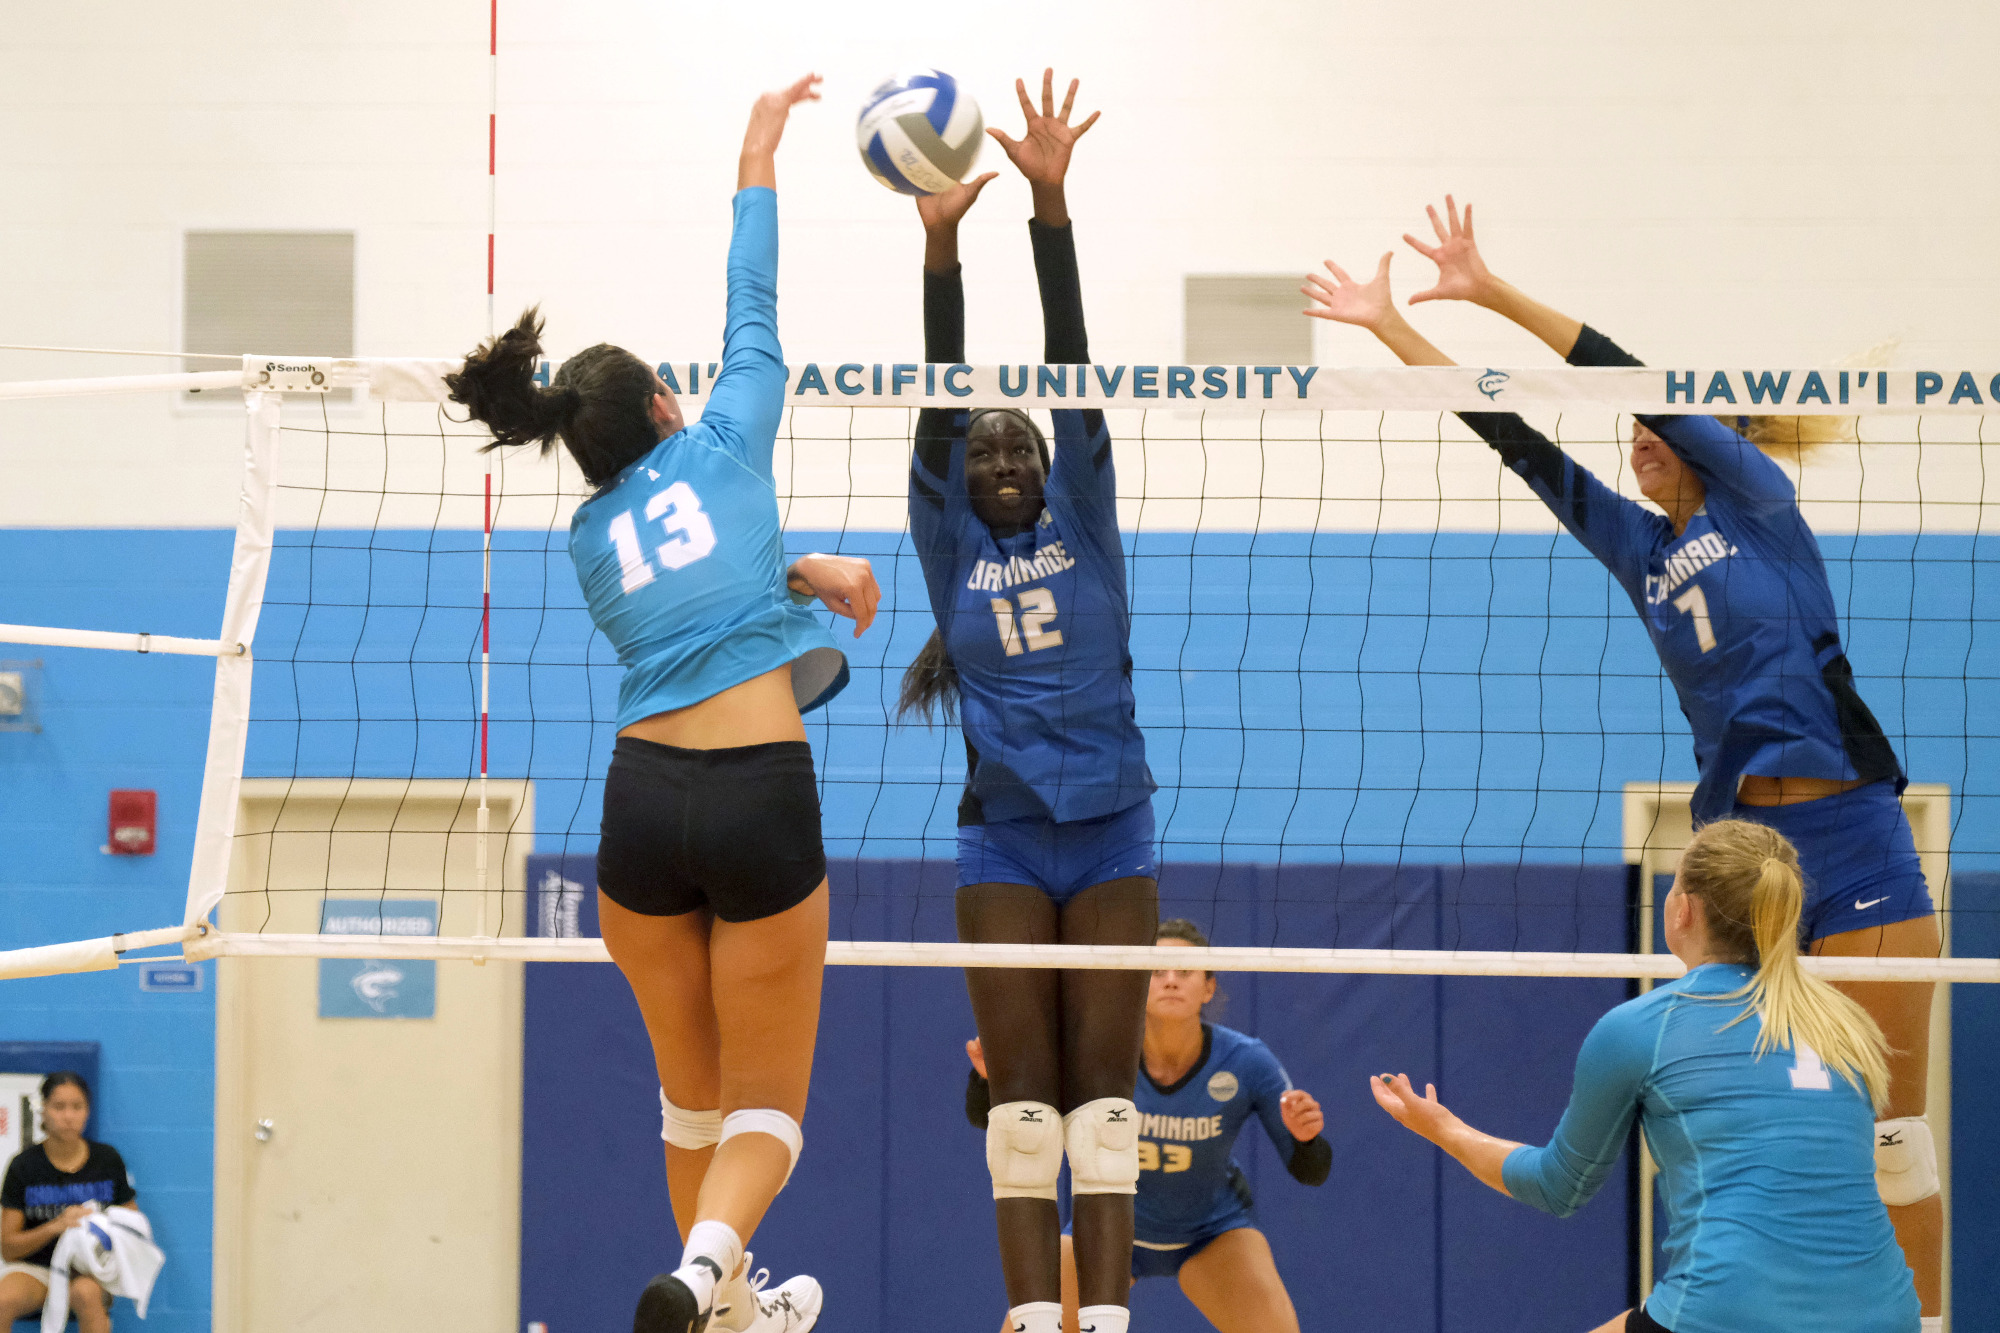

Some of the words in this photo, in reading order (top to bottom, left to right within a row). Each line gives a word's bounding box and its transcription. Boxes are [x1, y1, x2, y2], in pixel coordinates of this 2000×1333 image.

[277, 363, 316, 373] Senoh
[785, 362, 974, 397] ACIFIC
[999, 364, 1319, 399] UNIVERSITY
[1666, 370, 1888, 404] HAWAI'I
[607, 480, 719, 595] 13
[989, 586, 1065, 657] 12
[1672, 583, 1718, 655] 7
[1138, 1112, 1223, 1142] MINADE
